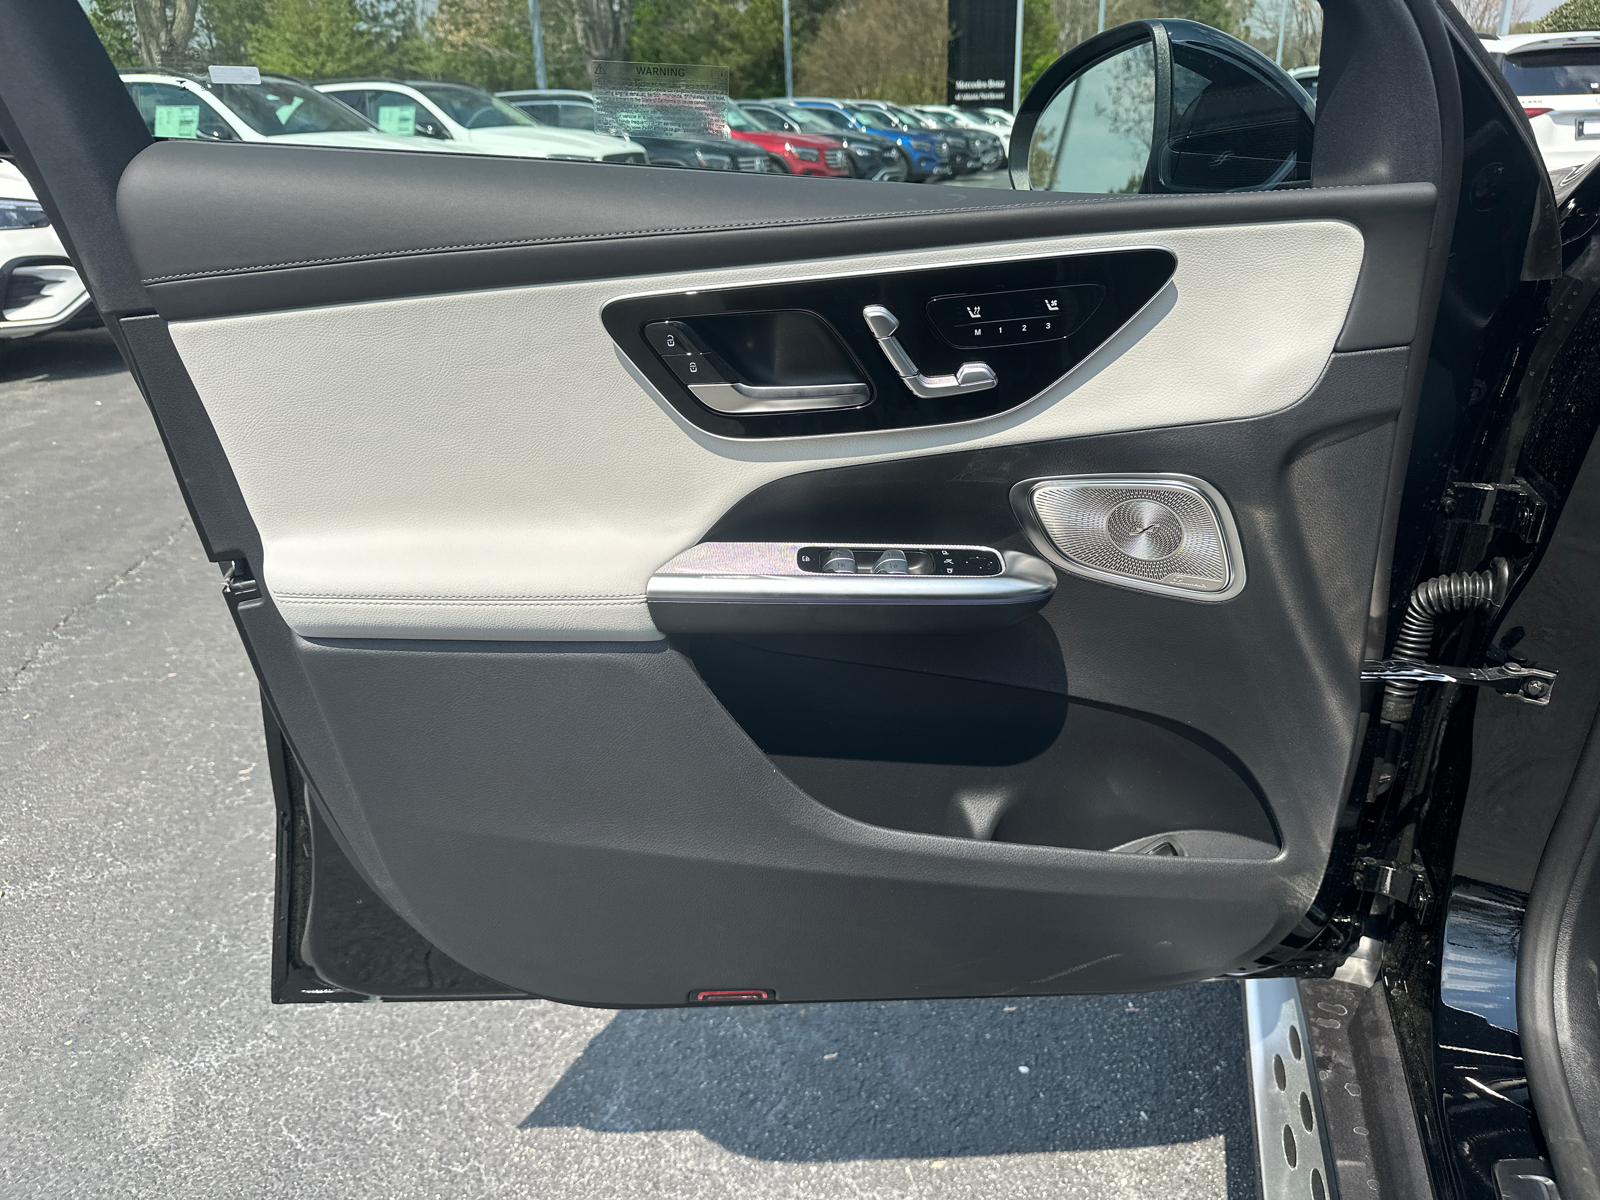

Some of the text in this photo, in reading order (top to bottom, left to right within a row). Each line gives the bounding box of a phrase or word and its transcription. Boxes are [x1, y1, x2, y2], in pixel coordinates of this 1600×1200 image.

[636, 66, 685, 77] WARNING
[1021, 324, 1027, 332] 2
[1045, 322, 1051, 330] 3
